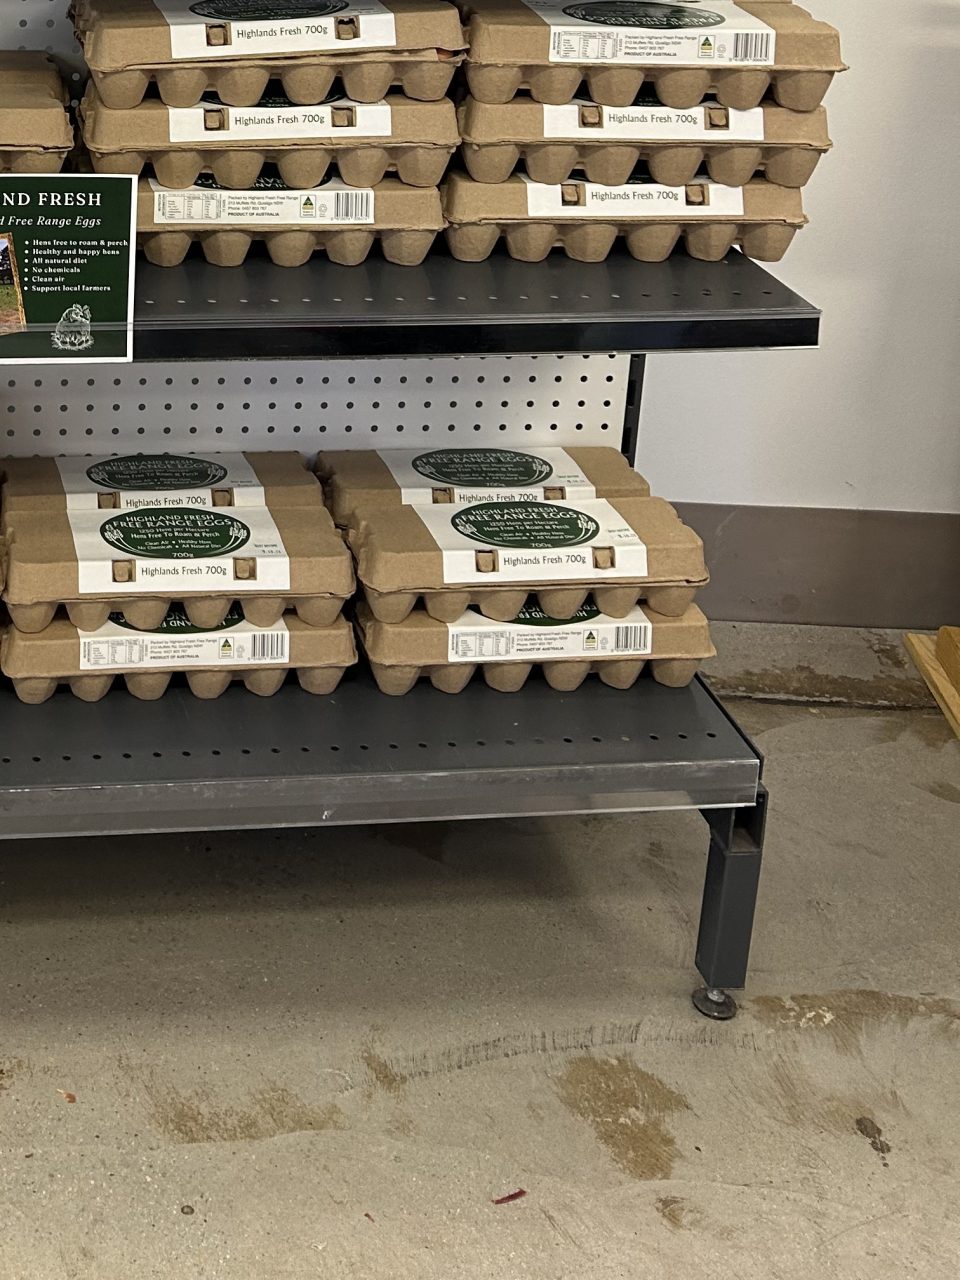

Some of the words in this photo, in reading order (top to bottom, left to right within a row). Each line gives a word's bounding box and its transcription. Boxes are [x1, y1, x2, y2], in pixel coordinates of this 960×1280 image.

[237, 28, 277, 39] Highlands
[280, 27, 301, 36] Fresh
[305, 25, 328, 34] 700g
[235, 116, 274, 126] Highlands
[278, 115, 298, 123] Fresh
[302, 114, 324, 124] 700g
[609, 114, 648, 124] Highlands
[651, 114, 672, 123] Fresh
[675, 115, 698, 125] 700g
[38, 193, 101, 206] FRESH
[592, 192, 630, 201] Highlands
[633, 192, 653, 200] Fresh
[657, 191, 678, 200] 700g
[8, 216, 33, 226] Free
[37, 216, 72, 228] Range
[75, 216, 101, 228] Eggs
[504, 556, 540, 567] Highlands
[543, 556, 562, 564] Fresh
[566, 554, 586, 564] 700g
[142, 567, 179, 577] Highlands
[182, 566, 202, 574] Fresh
[206, 566, 226, 575] 700g
